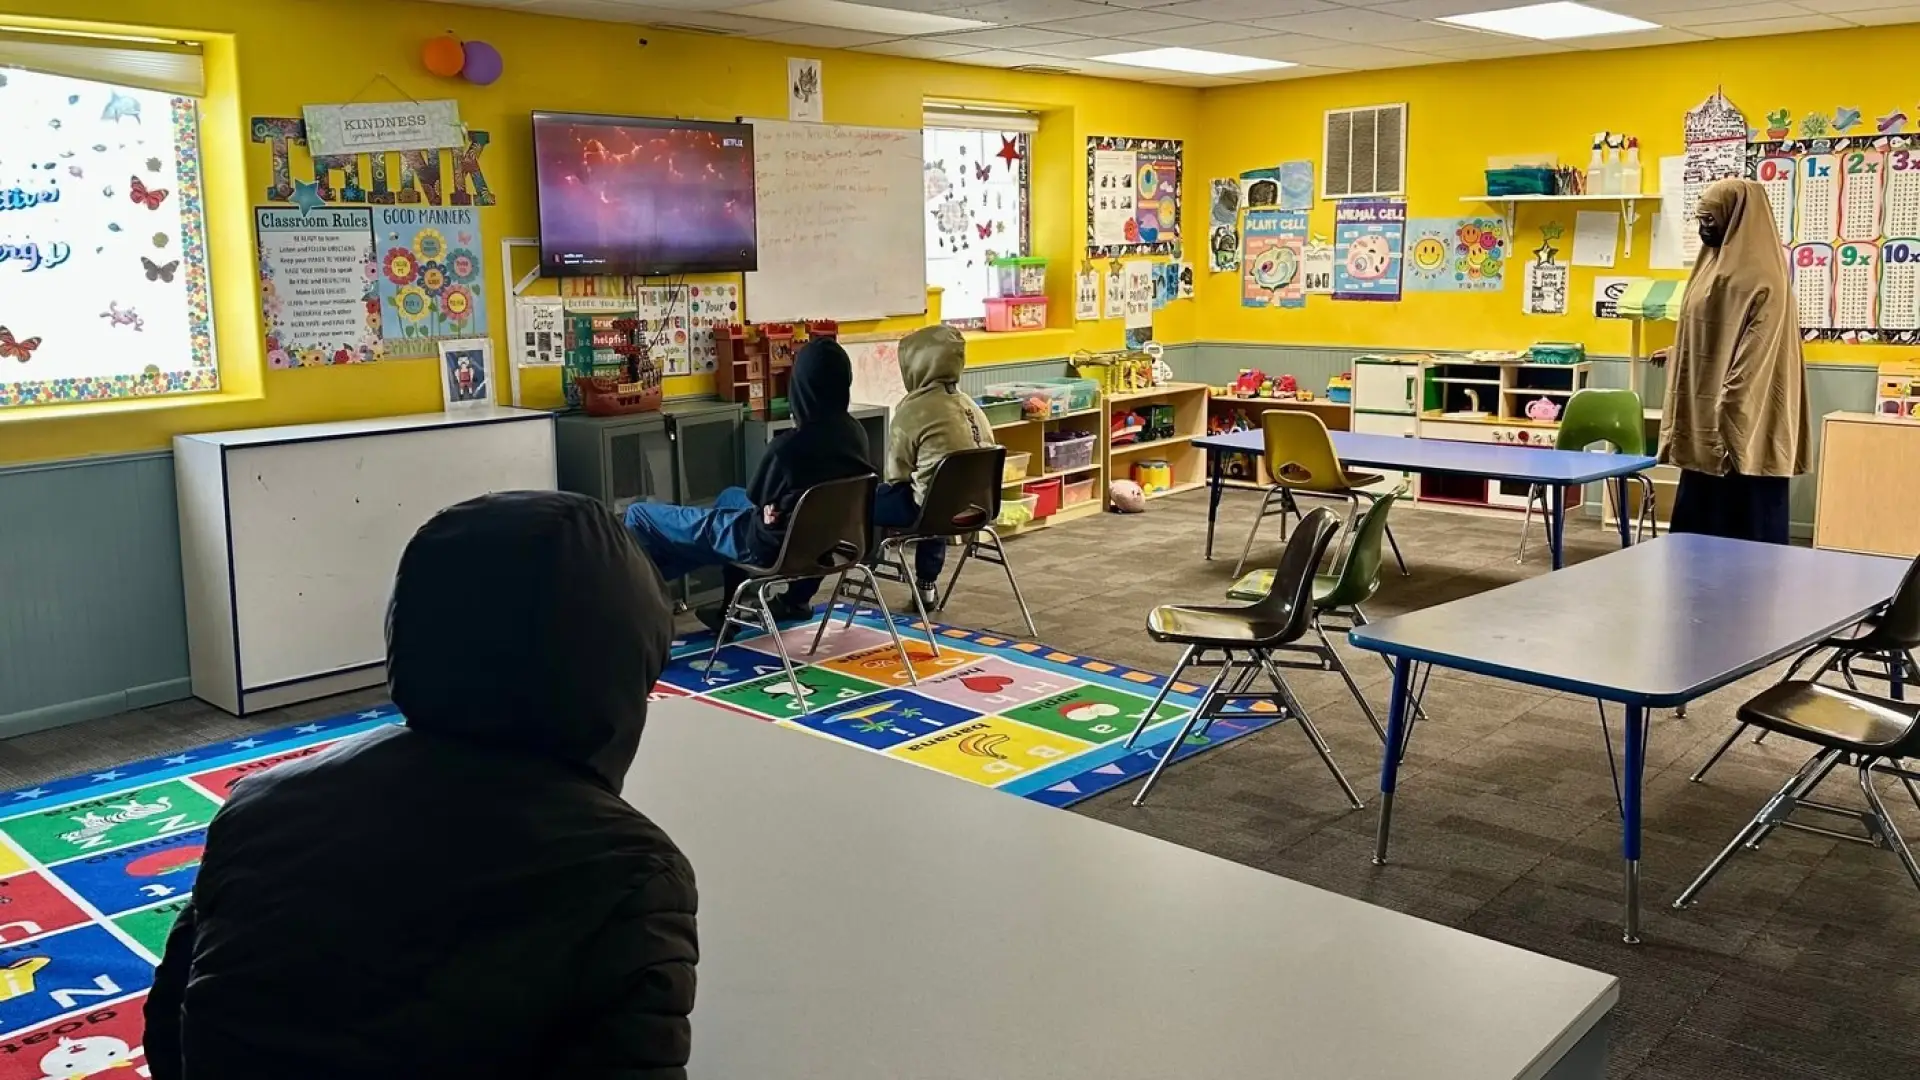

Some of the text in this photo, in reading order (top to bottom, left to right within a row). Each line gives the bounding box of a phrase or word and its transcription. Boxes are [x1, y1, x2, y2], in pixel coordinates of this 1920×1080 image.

[344, 114, 427, 131] KINDNESS
[251, 117, 496, 206] THINK
[1806, 157, 1831, 177] 1x
[1847, 153, 1879, 174] 2x
[261, 212, 368, 228] Classroom Rules
[383, 208, 472, 225] GOOD MANNERS
[1336, 208, 1405, 222] ANIMAL CELL
[1246, 218, 1306, 231] PLANT CELL
[1797, 246, 1828, 268] 8x
[1841, 246, 1872, 266] 9x
[705, 300, 724, 314] Your
[908, 722, 992, 752] banana
